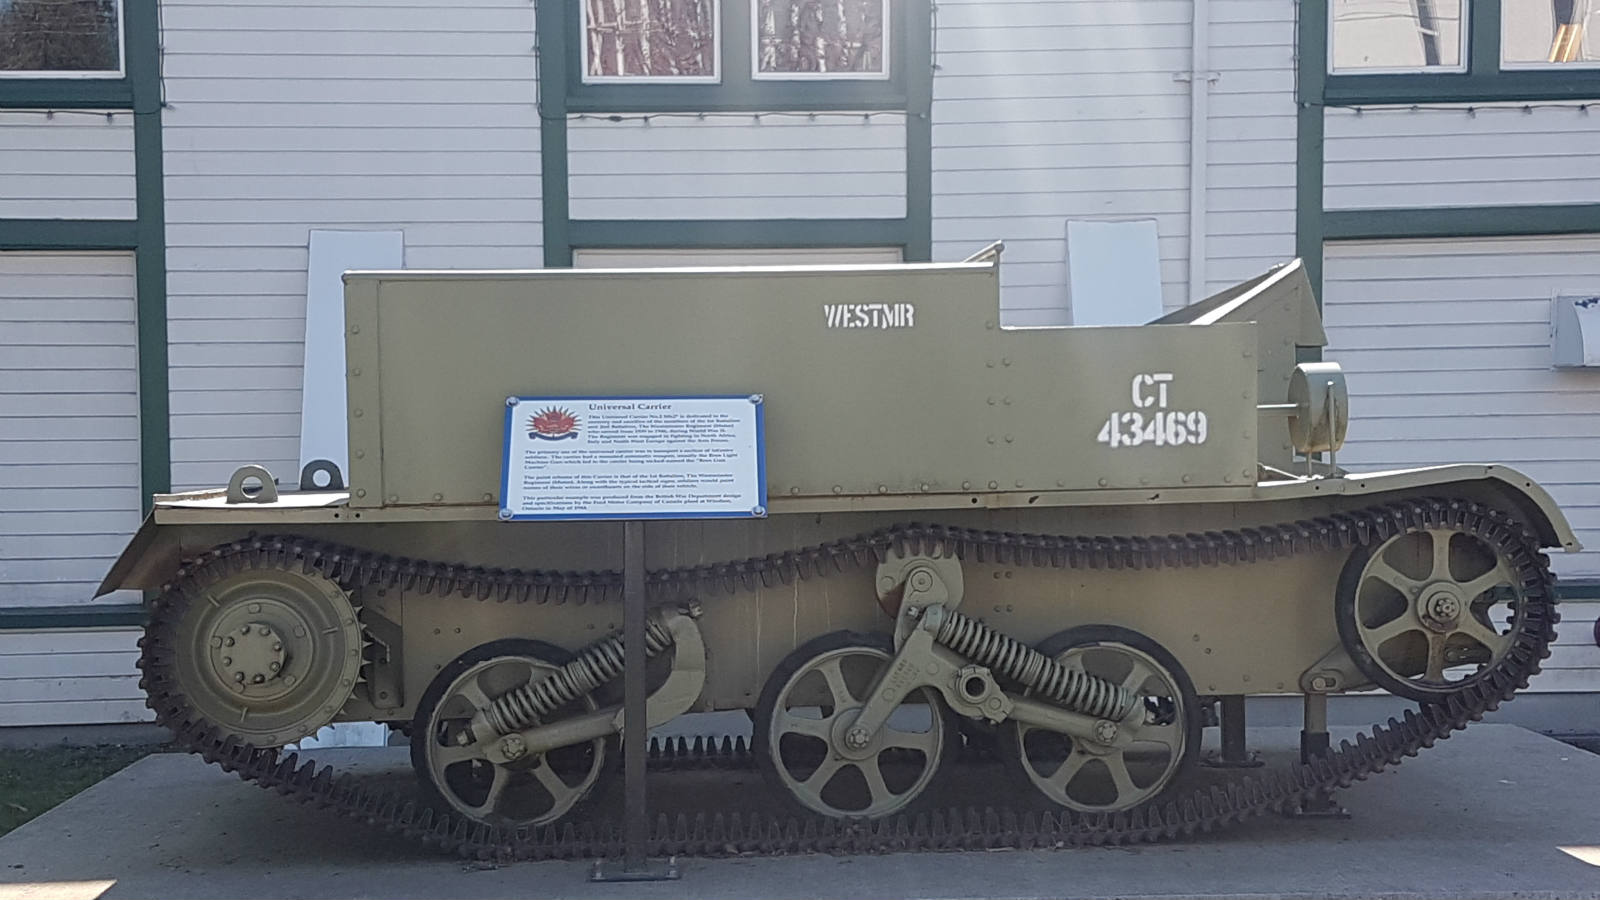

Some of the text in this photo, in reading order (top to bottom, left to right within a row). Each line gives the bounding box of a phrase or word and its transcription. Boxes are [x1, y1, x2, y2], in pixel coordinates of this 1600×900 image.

[823, 303, 915, 329] WESTMR
[1131, 373, 1174, 409] CT
[588, 403, 635, 411] Universal
[1096, 410, 1208, 449] 43469
